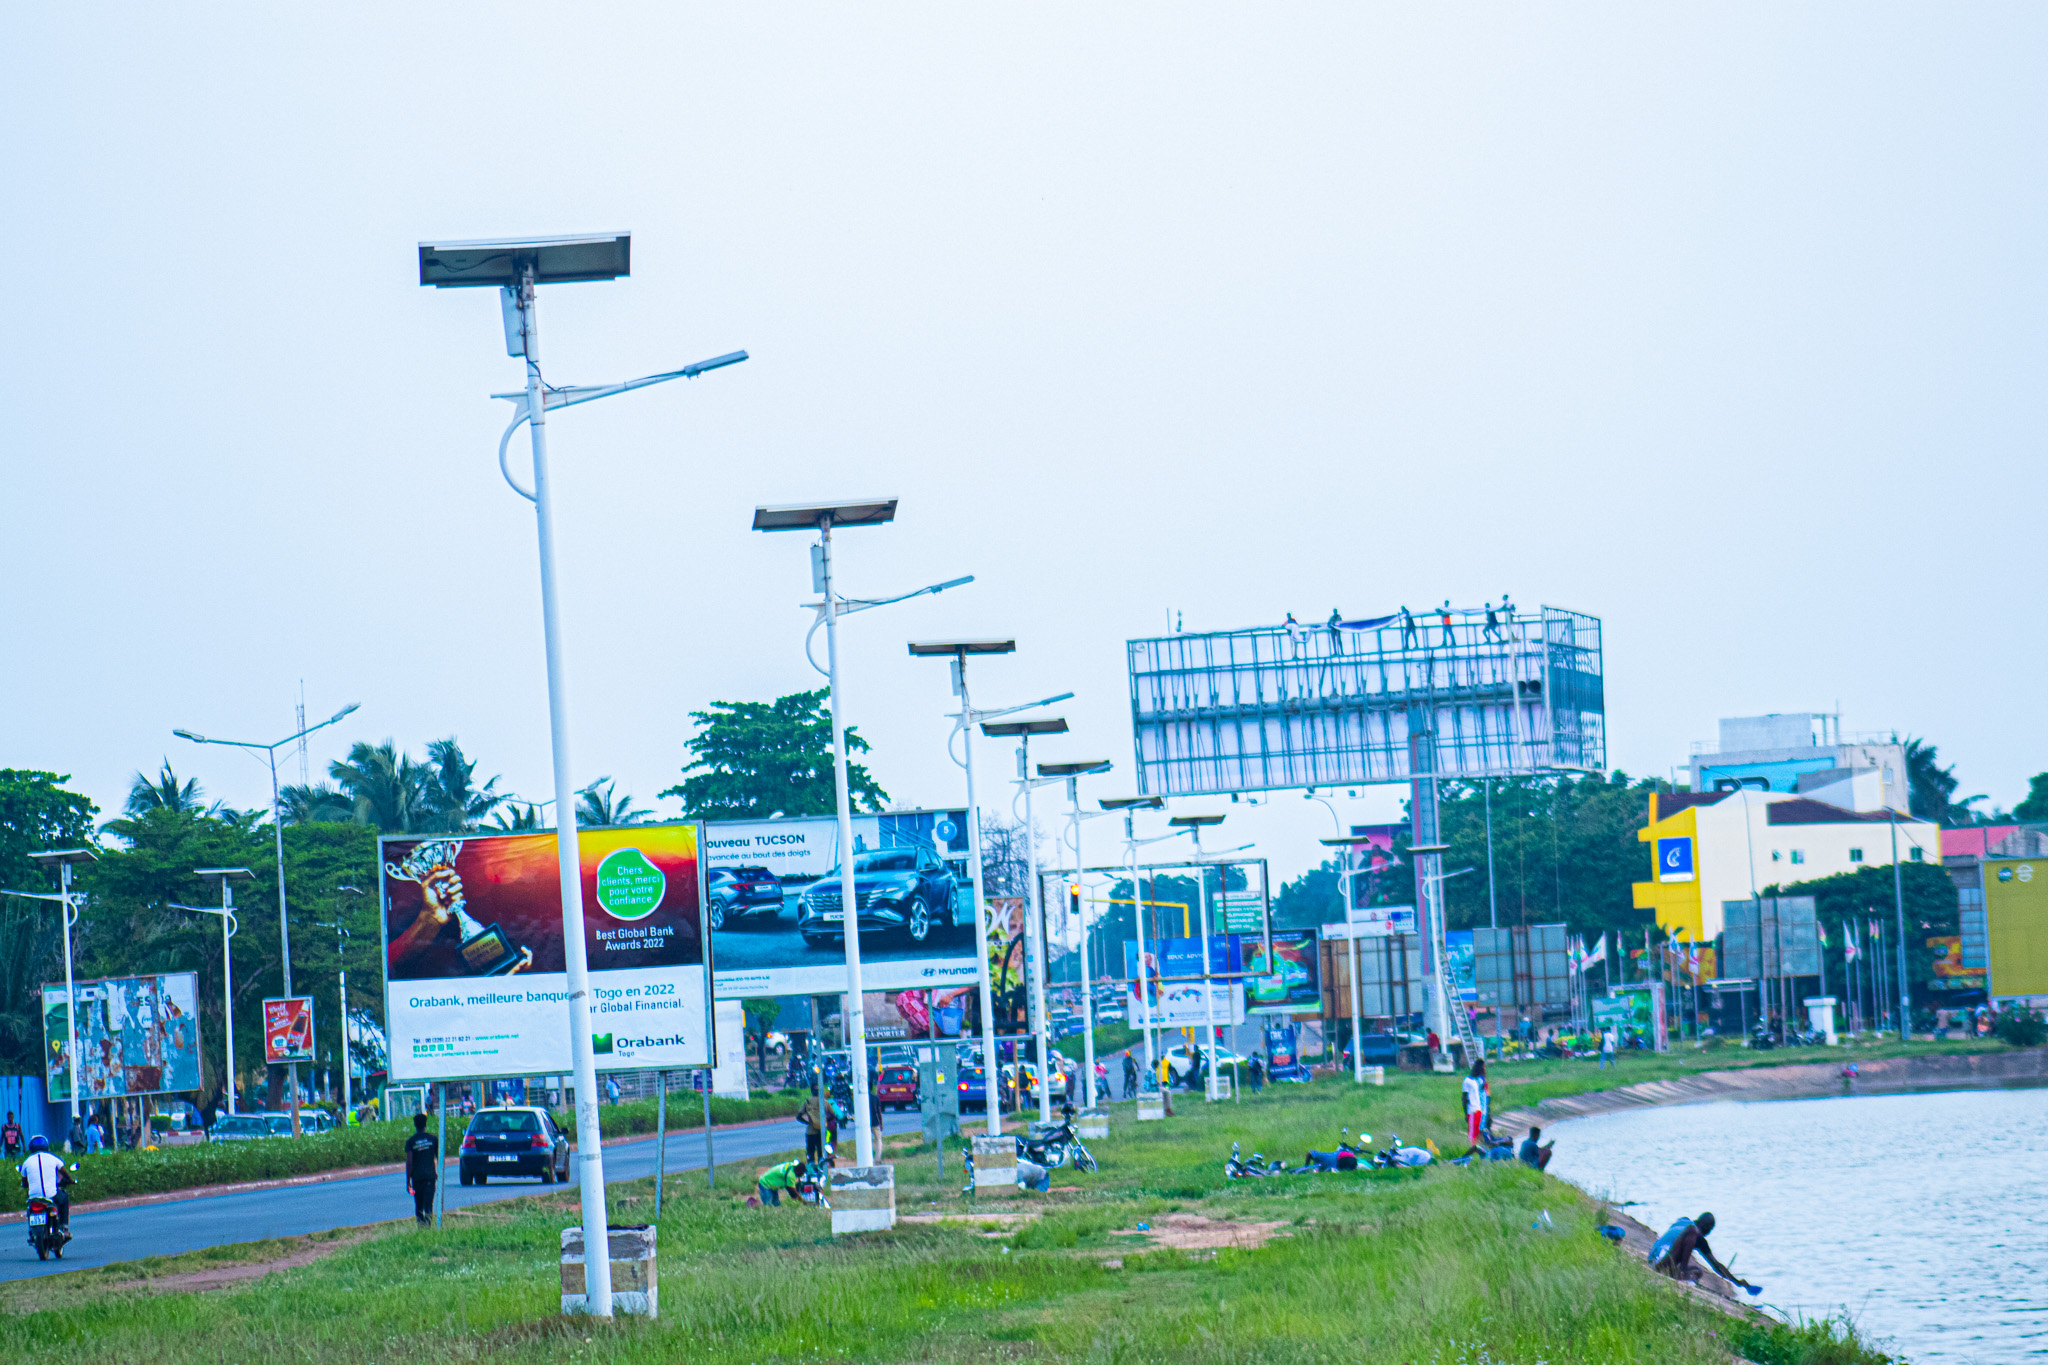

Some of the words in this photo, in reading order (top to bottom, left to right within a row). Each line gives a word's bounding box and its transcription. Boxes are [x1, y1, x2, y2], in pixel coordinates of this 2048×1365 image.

[942, 826, 949, 834] 5
[707, 838, 750, 848] ouveau
[755, 834, 805, 846] TUCSON
[753, 850, 770, 859] bout
[772, 849, 786, 857] des
[787, 848, 811, 858] doigts
[617, 866, 643, 875] Chers
[601, 876, 633, 887] clients,
[635, 874, 660, 884] merci
[609, 887, 629, 897] pour
[631, 885, 653, 895] votre
[609, 895, 655, 906] confiance.
[596, 928, 616, 940] Best
[618, 926, 648, 938] Global
[649, 924, 675, 937] Bank
[605, 938, 641, 951] Awards
[643, 936, 665, 948] 2022
[938, 966, 978, 976] HYUNDAI
[409, 995, 464, 1008] Orabank,
[467, 993, 523, 1004] meilleure
[594, 988, 623, 1001] Togo
[626, 987, 641, 997] en
[644, 984, 675, 996] 2022
[600, 1001, 632, 1014] Global
[635, 998, 685, 1011] Financial.
[617, 1034, 686, 1048] Orabank
[618, 1050, 635, 1058] Togo
